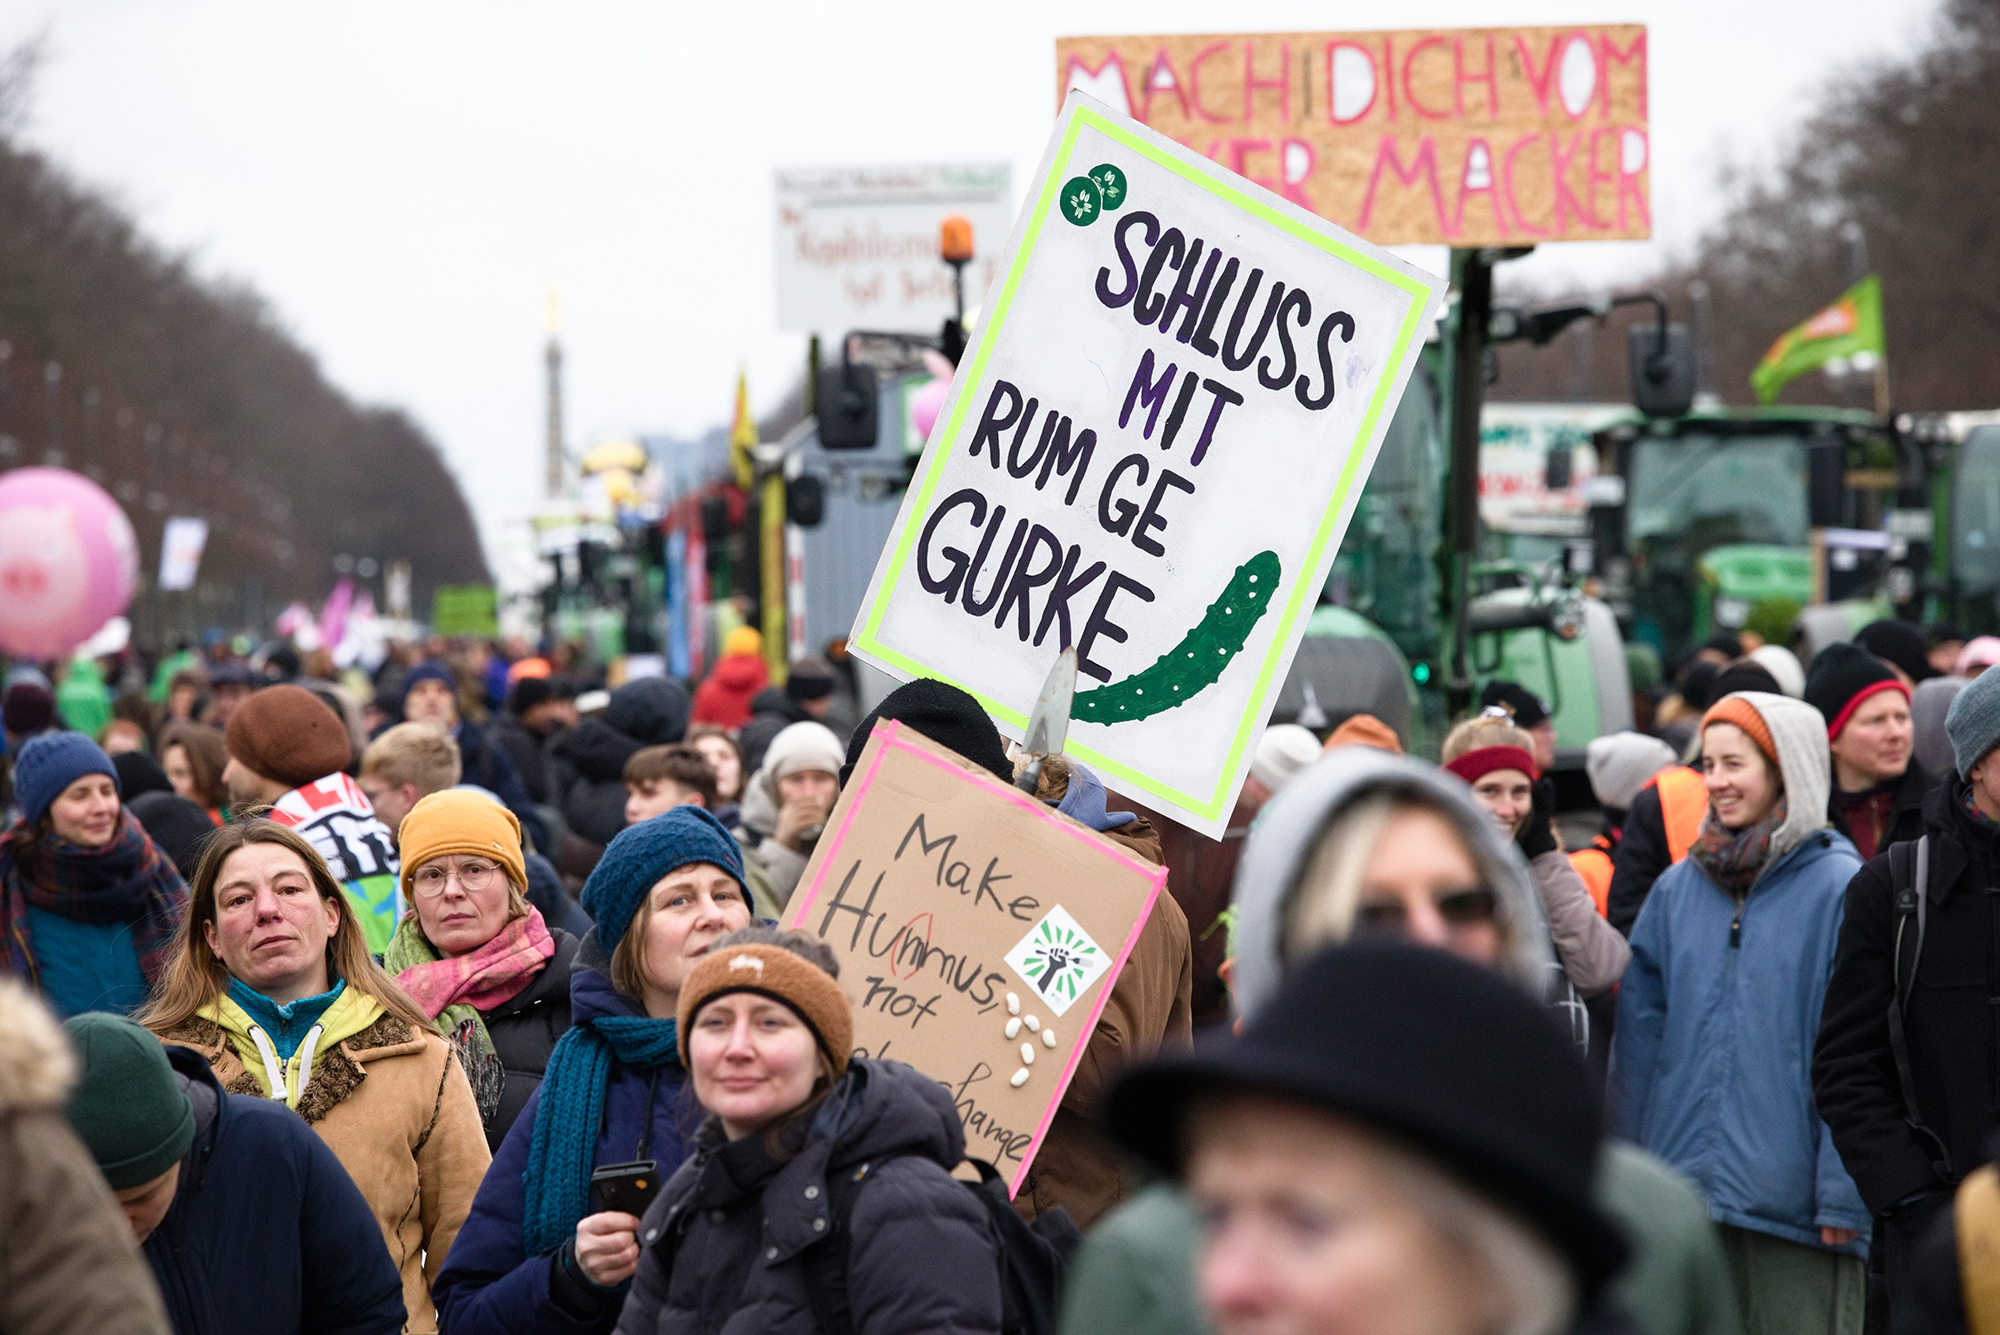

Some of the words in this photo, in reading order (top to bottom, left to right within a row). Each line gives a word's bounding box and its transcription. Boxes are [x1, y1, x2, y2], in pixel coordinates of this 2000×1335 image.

[1055, 44, 1292, 127] MACH
[1326, 35, 1499, 126] DICH
[1512, 30, 1649, 121] VOM
[1355, 128, 1652, 239] MACKER
[1095, 211, 1355, 411] SCHLUSS
[1118, 348, 1244, 466] MIT
[969, 379, 1097, 505] RUM
[1098, 453, 1195, 557] GE
[916, 488, 1155, 683] GURKE
[894, 813, 1040, 922] Make
[865, 976, 942, 1029] not
[937, 1062, 1033, 1167] hange
